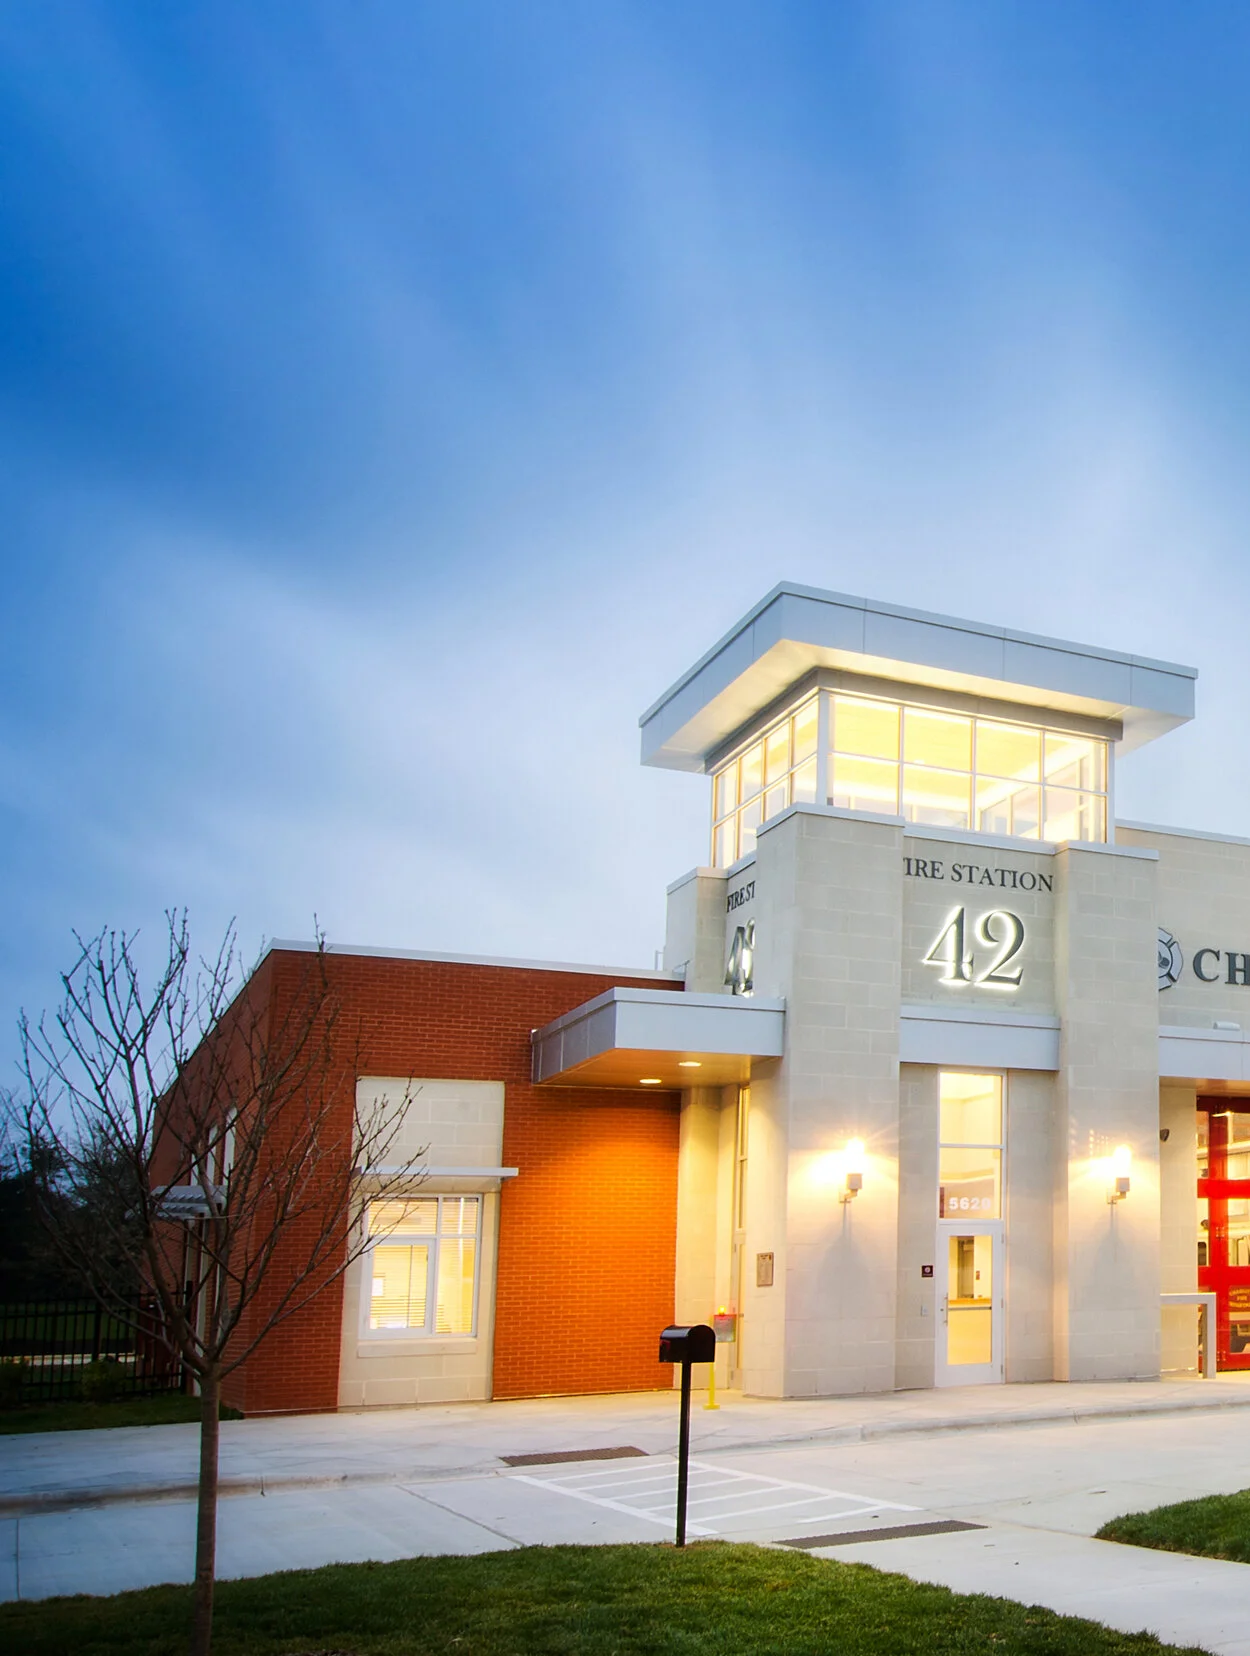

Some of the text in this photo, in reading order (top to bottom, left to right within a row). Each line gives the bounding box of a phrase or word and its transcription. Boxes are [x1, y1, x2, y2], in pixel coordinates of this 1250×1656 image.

[903, 857, 1053, 892] IRE STATION
[922, 904, 1025, 991] 42
[948, 1196, 992, 1211] 5620
